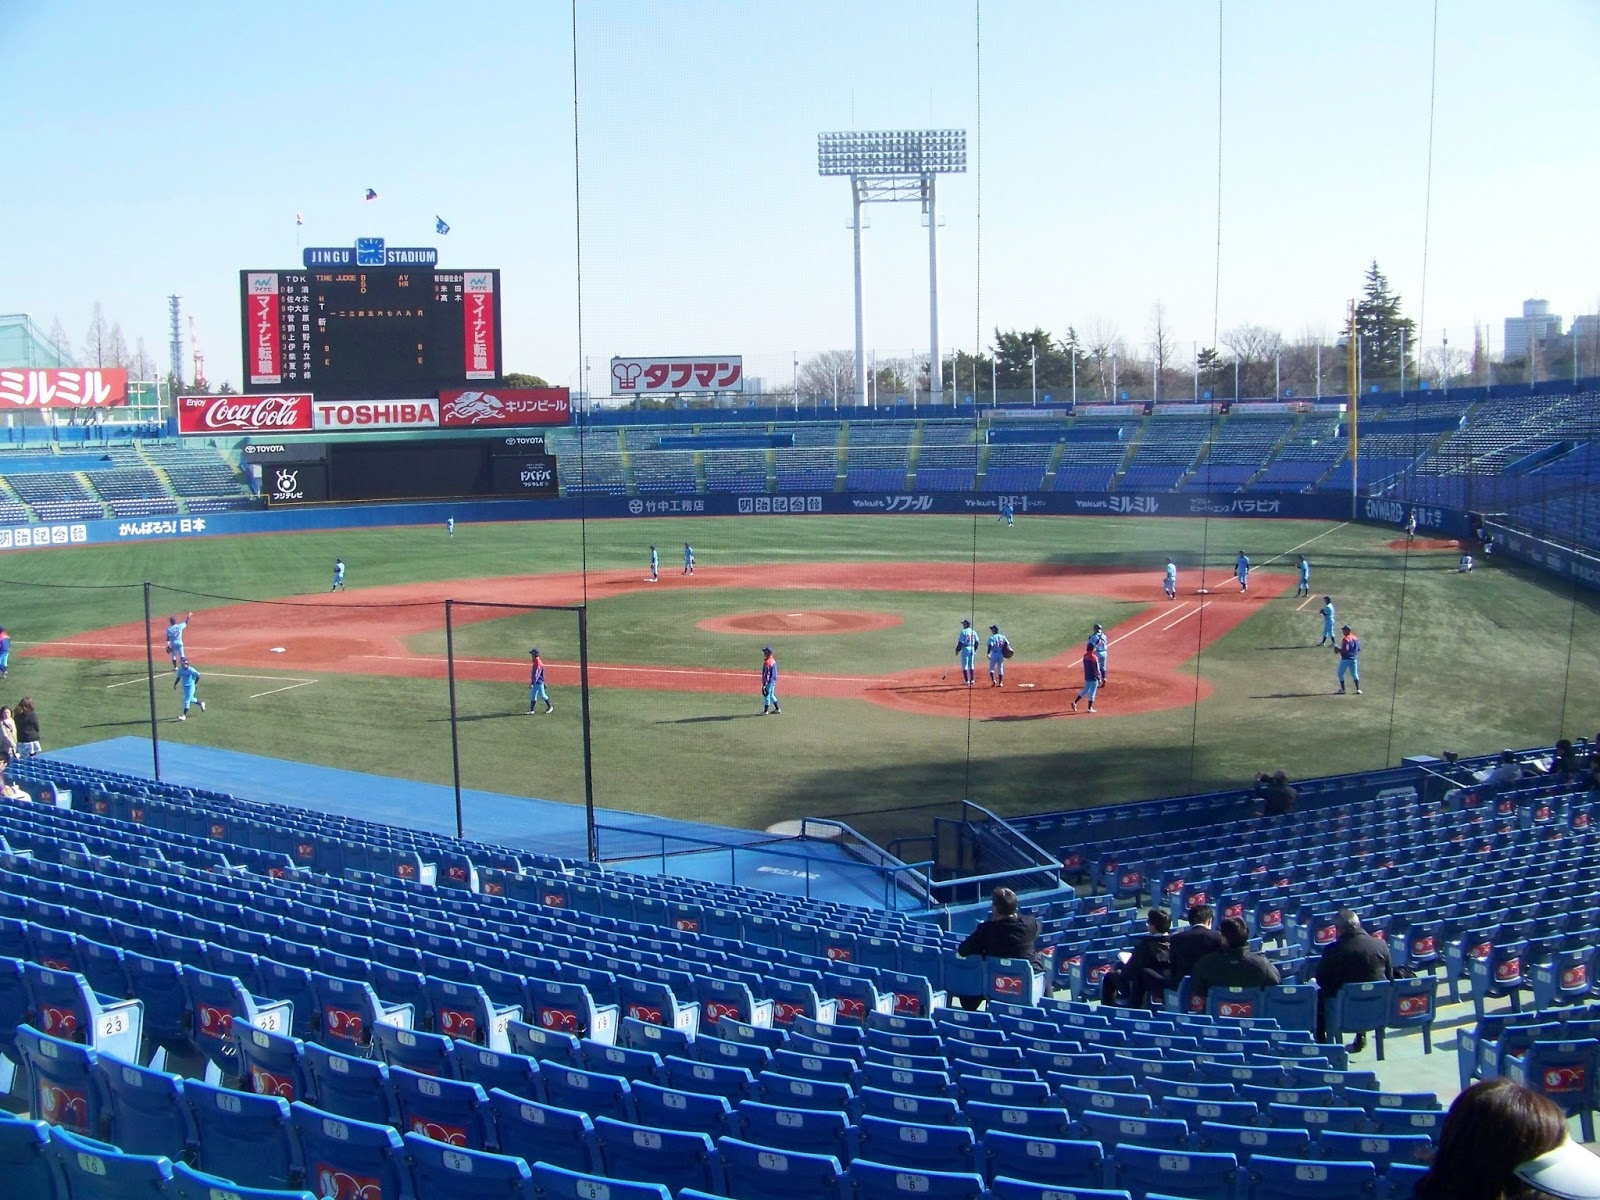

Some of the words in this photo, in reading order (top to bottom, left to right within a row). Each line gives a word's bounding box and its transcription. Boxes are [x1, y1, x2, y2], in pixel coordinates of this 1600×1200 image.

[312, 251, 349, 262] JINGU
[388, 251, 435, 262] STADIUM
[257, 296, 273, 374] マイナビ転職
[473, 294, 487, 369] マイナビ転職
[643, 363, 741, 388] タフマン
[0, 371, 111, 405] ミルミル
[186, 399, 206, 407] Enjoy
[205, 397, 300, 428] Coca-Cola
[505, 400, 567, 413] キリンビール
[319, 404, 435, 425] TOSHIBA
[517, 437, 544, 445] TOYOTA
[256, 445, 285, 453] TOYOTA
[273, 491, 303, 499] フジテレビ
[646, 500, 704, 512] 竹中工務店
[739, 498, 822, 512] 明治記念館
[886, 496, 933, 511] ソフール
[1109, 496, 1158, 512] ミルミル
[1232, 500, 1280, 512] パラビオ
[1366, 499, 1403, 522] ONWARD
[0, 527, 86, 546] 明治記念館
[106, 1021, 122, 1034] 23
[261, 1019, 275, 1031] 22
[85, 1161, 98, 1172] 10
